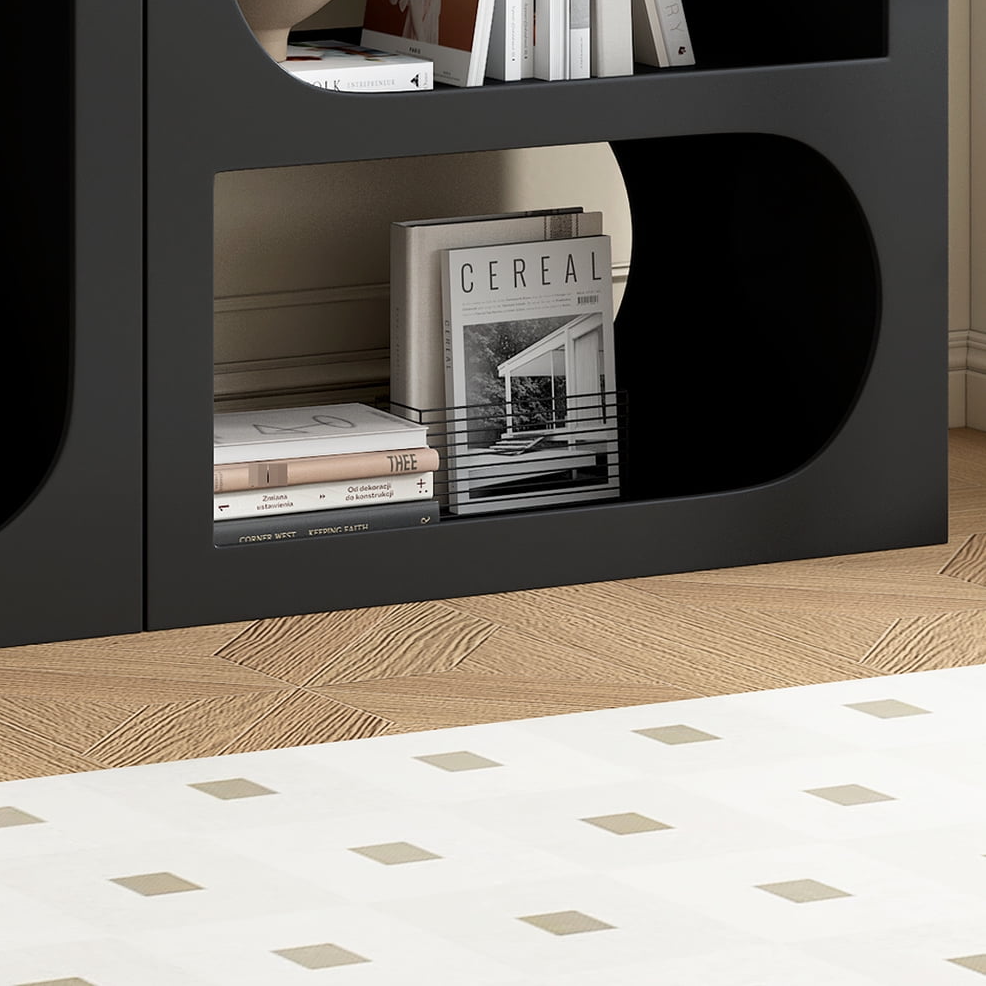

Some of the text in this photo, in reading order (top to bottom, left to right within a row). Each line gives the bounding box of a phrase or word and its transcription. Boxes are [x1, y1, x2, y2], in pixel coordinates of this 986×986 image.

[460, 251, 602, 294] CEREAL
[444, 319, 452, 369] CEREAL
[386, 454, 418, 472] THEE
[347, 482, 391, 493] Od dekoracji
[355, 490, 394, 500] konstrukcji
[256, 501, 294, 511] ustawienia
